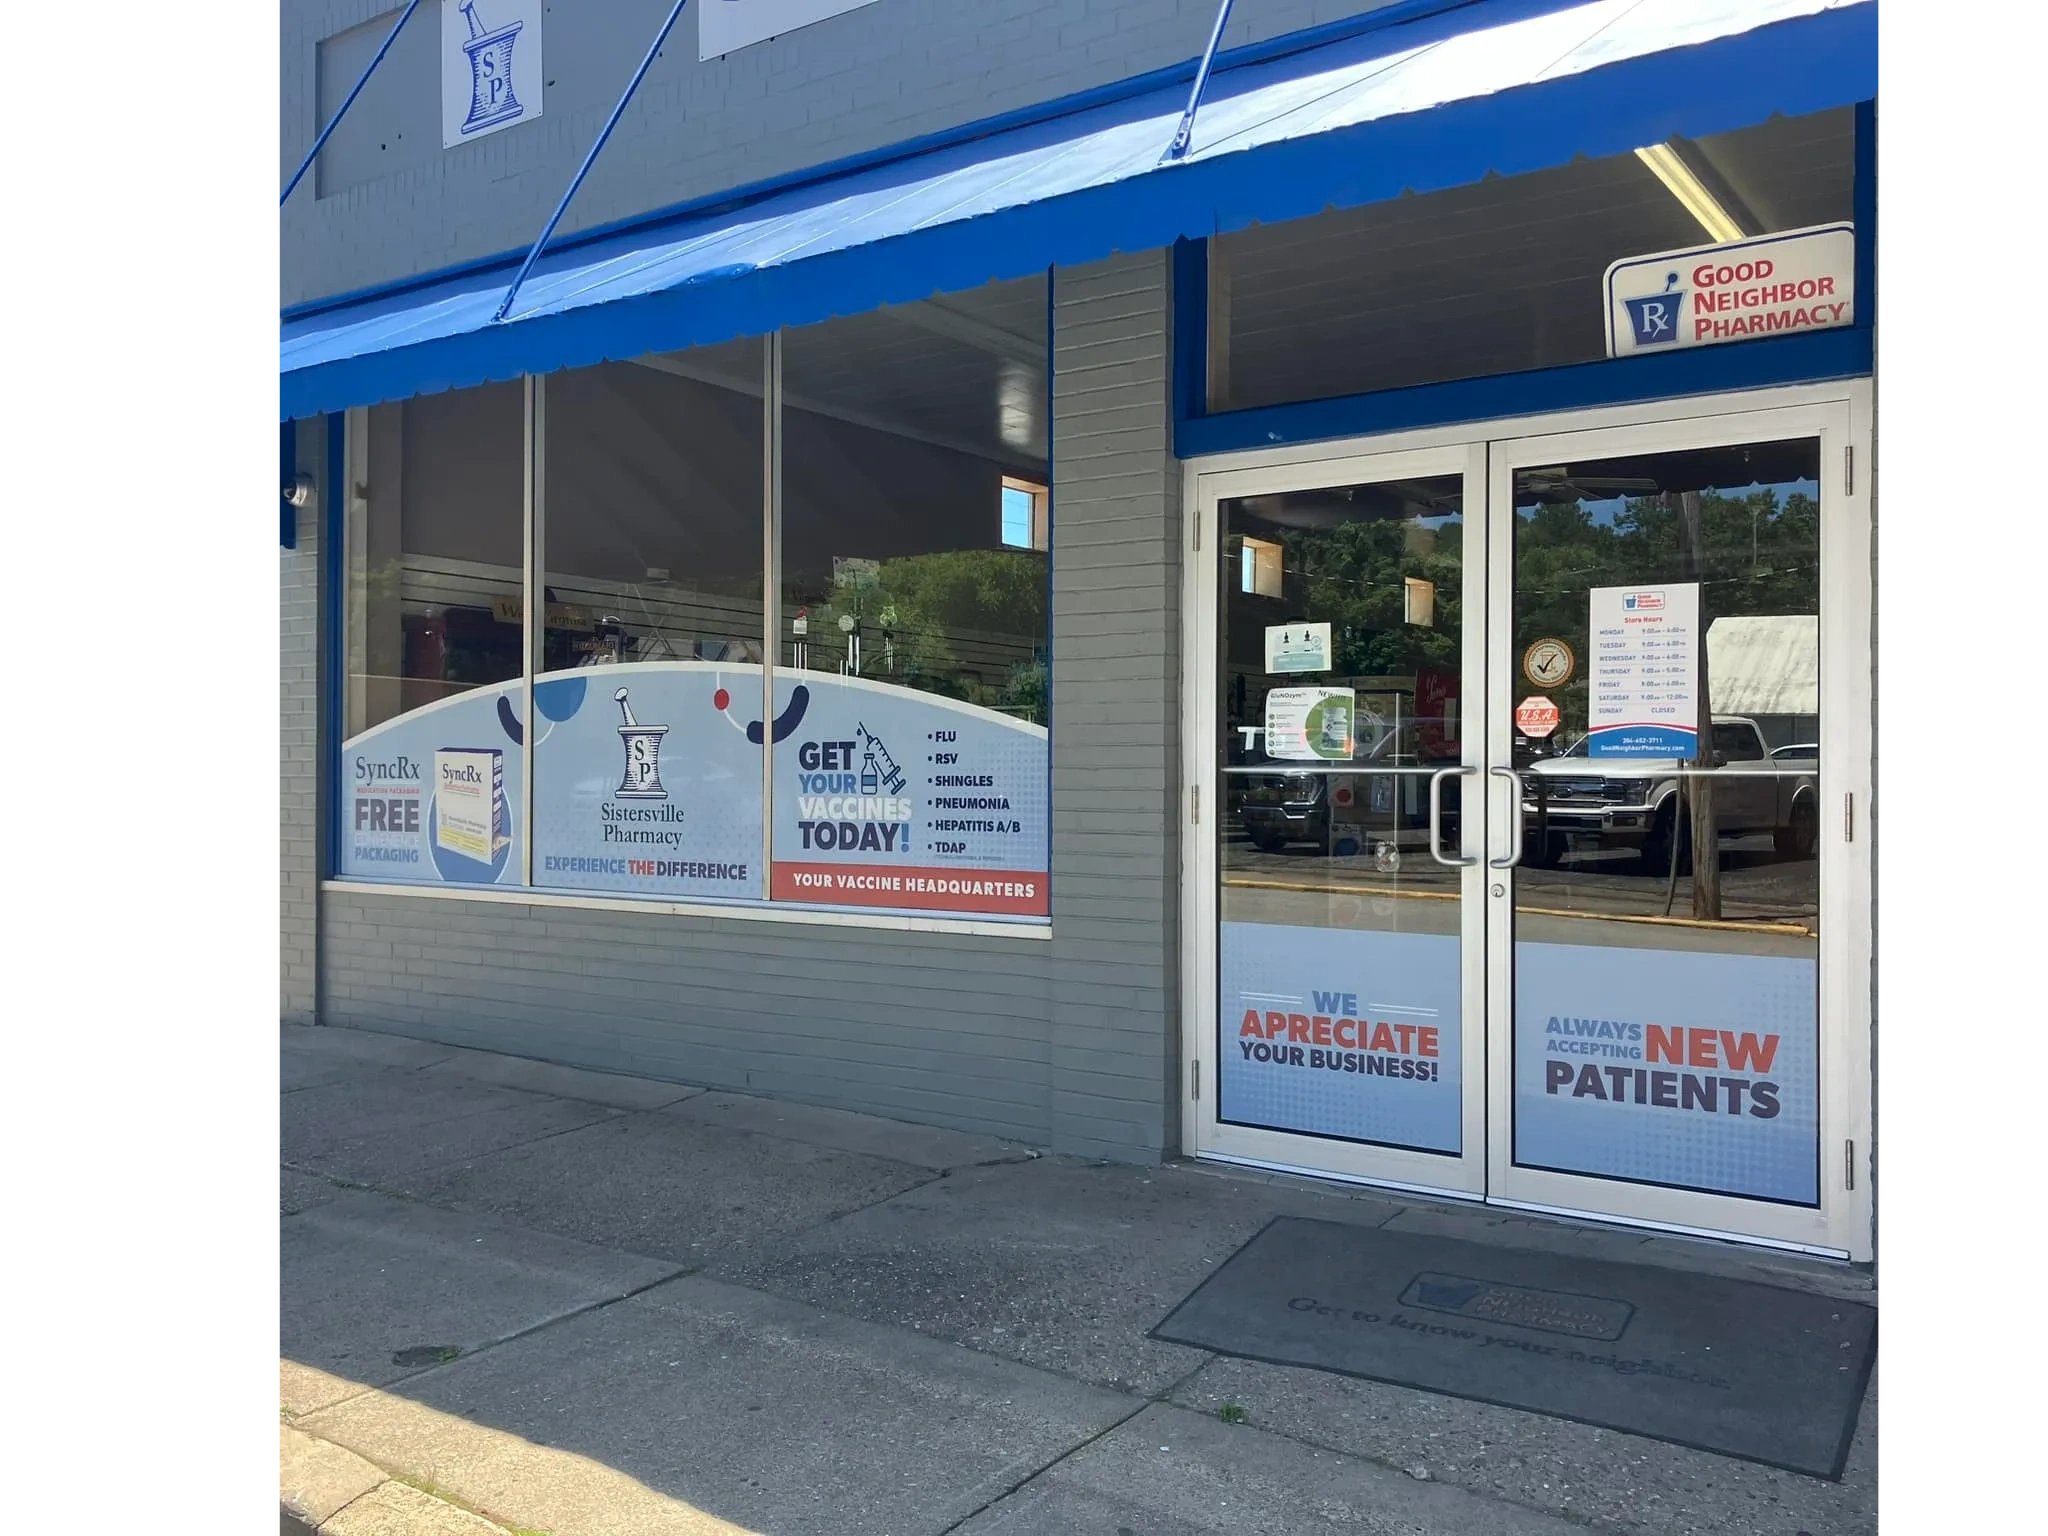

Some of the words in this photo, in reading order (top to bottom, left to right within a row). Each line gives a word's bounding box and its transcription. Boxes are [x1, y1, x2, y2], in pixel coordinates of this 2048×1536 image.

[483, 51, 495, 78] S
[488, 77, 503, 105] P
[1693, 259, 1774, 288] GOOD
[1694, 276, 1835, 315] NEIGHBOR
[1695, 302, 1846, 342] PHARMACY
[935, 731, 956, 743] FLU
[634, 740, 645, 761] S
[799, 741, 856, 771] GET
[935, 753, 958, 765] RSV
[355, 756, 420, 786] SyncRx
[442, 763, 482, 784] SyncRx
[639, 763, 651, 783] P
[935, 775, 993, 788] SHINGLES
[799, 774, 857, 794] YOUR
[355, 798, 419, 833] FREE
[601, 803, 685, 823] Sistersville
[798, 797, 912, 821] VACCINES
[935, 797, 1010, 810] PNEUMONIA
[603, 824, 683, 850] Pharmacy
[798, 821, 909, 853] TODAY!
[935, 820, 994, 833] HEPATITIS
[996, 821, 1021, 834] A/B
[354, 847, 419, 863] PACKAGING
[935, 842, 966, 854] TDAP
[545, 856, 626, 875] EXPERIENCE
[628, 859, 655, 876] THE
[657, 861, 747, 881] DIFFERENCE
[793, 873, 832, 888] YOUR
[837, 876, 900, 891] VACCINE
[905, 878, 1035, 898] HEADQUARTERS
[1312, 990, 1358, 1016] WE
[1240, 1009, 1439, 1057] APRECIATE
[1546, 1016, 1642, 1042] ALWAYS
[1646, 1024, 1780, 1073] NEW
[1239, 1041, 1305, 1067] YOUR
[1310, 1049, 1439, 1082] BUSINESS!
[1546, 1039, 1641, 1059] ACCEPTING
[1546, 1060, 1781, 1119] PATIENTS
